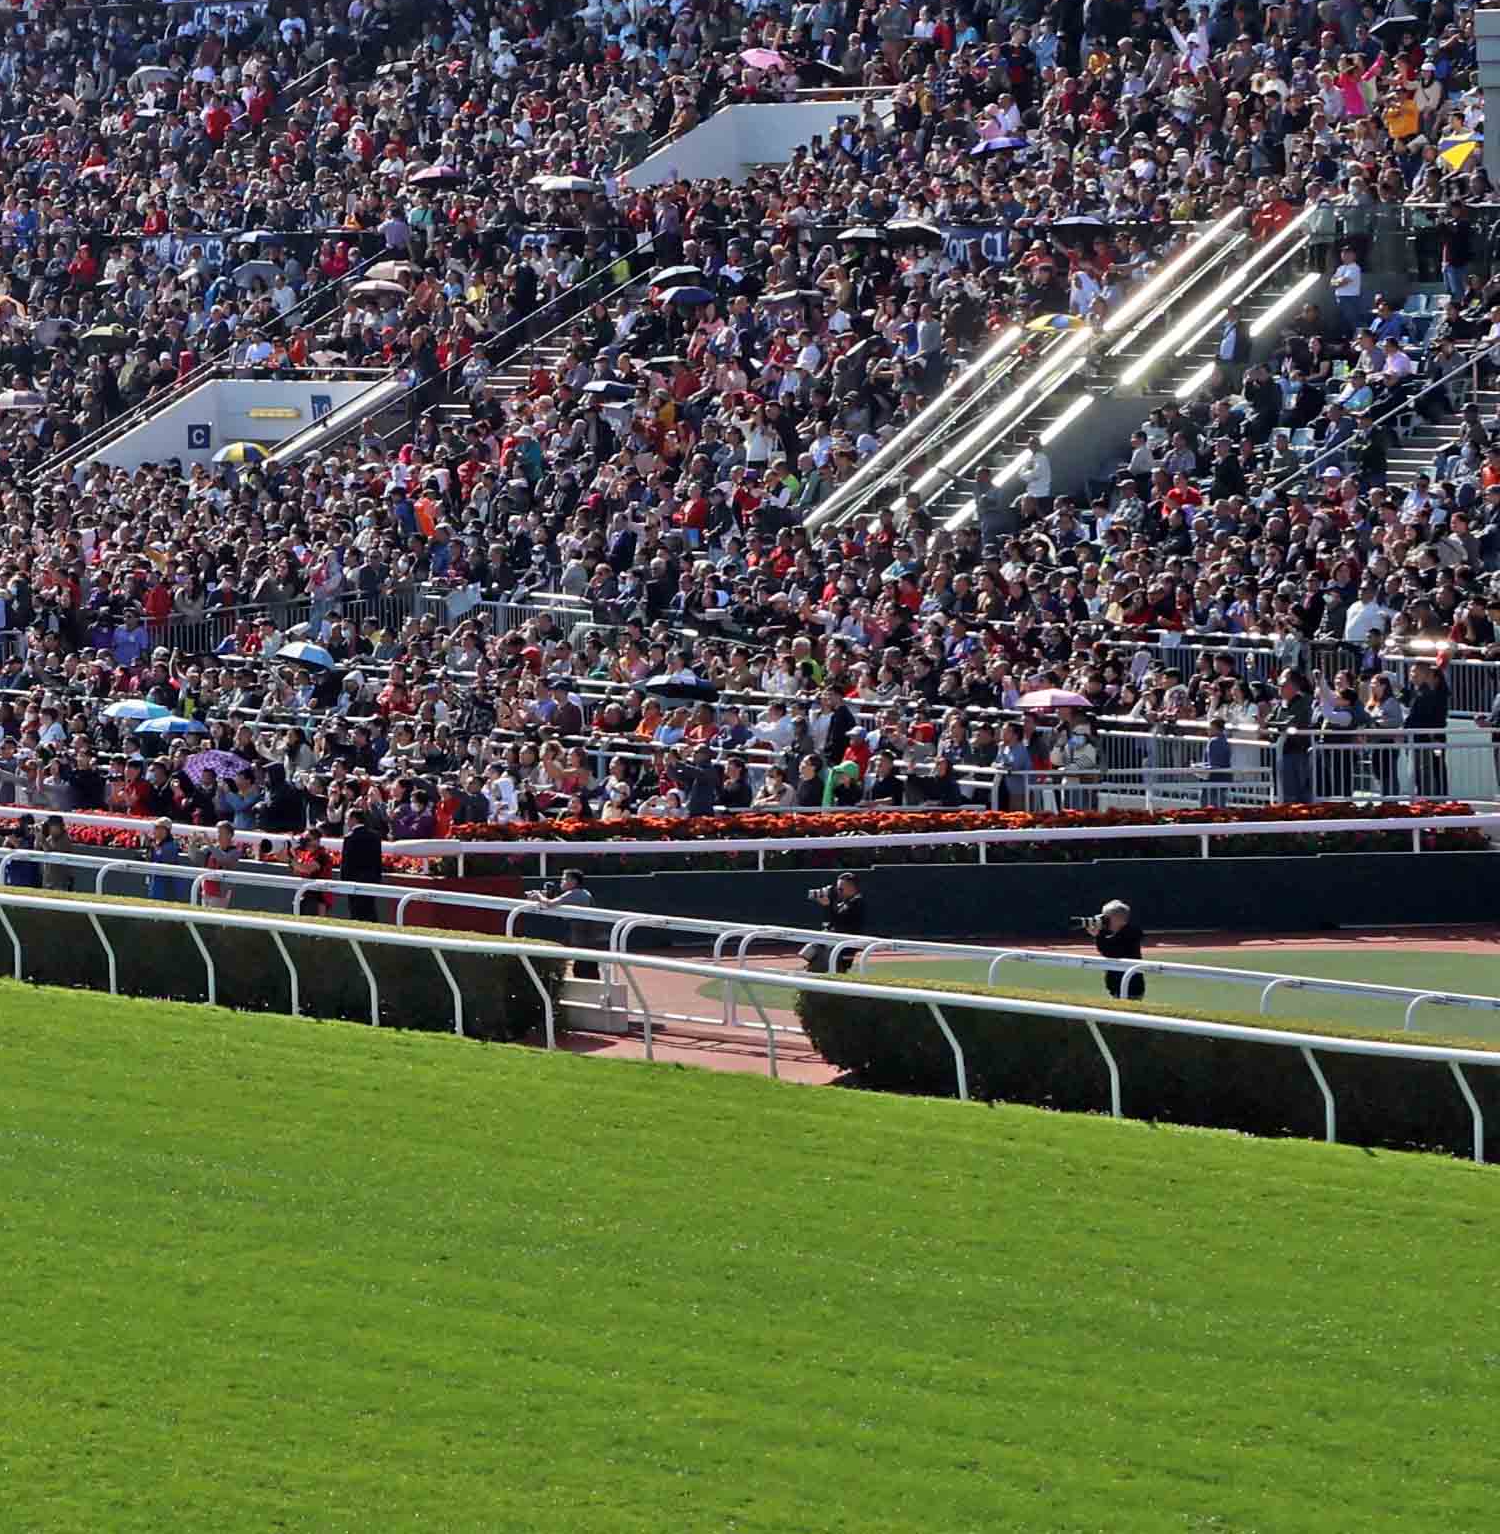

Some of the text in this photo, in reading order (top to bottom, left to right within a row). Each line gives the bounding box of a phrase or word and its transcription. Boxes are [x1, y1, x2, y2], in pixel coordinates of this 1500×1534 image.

[206, 240, 225, 265] C3
[940, 232, 1005, 263] Zon C1
[192, 429, 205, 444] C
